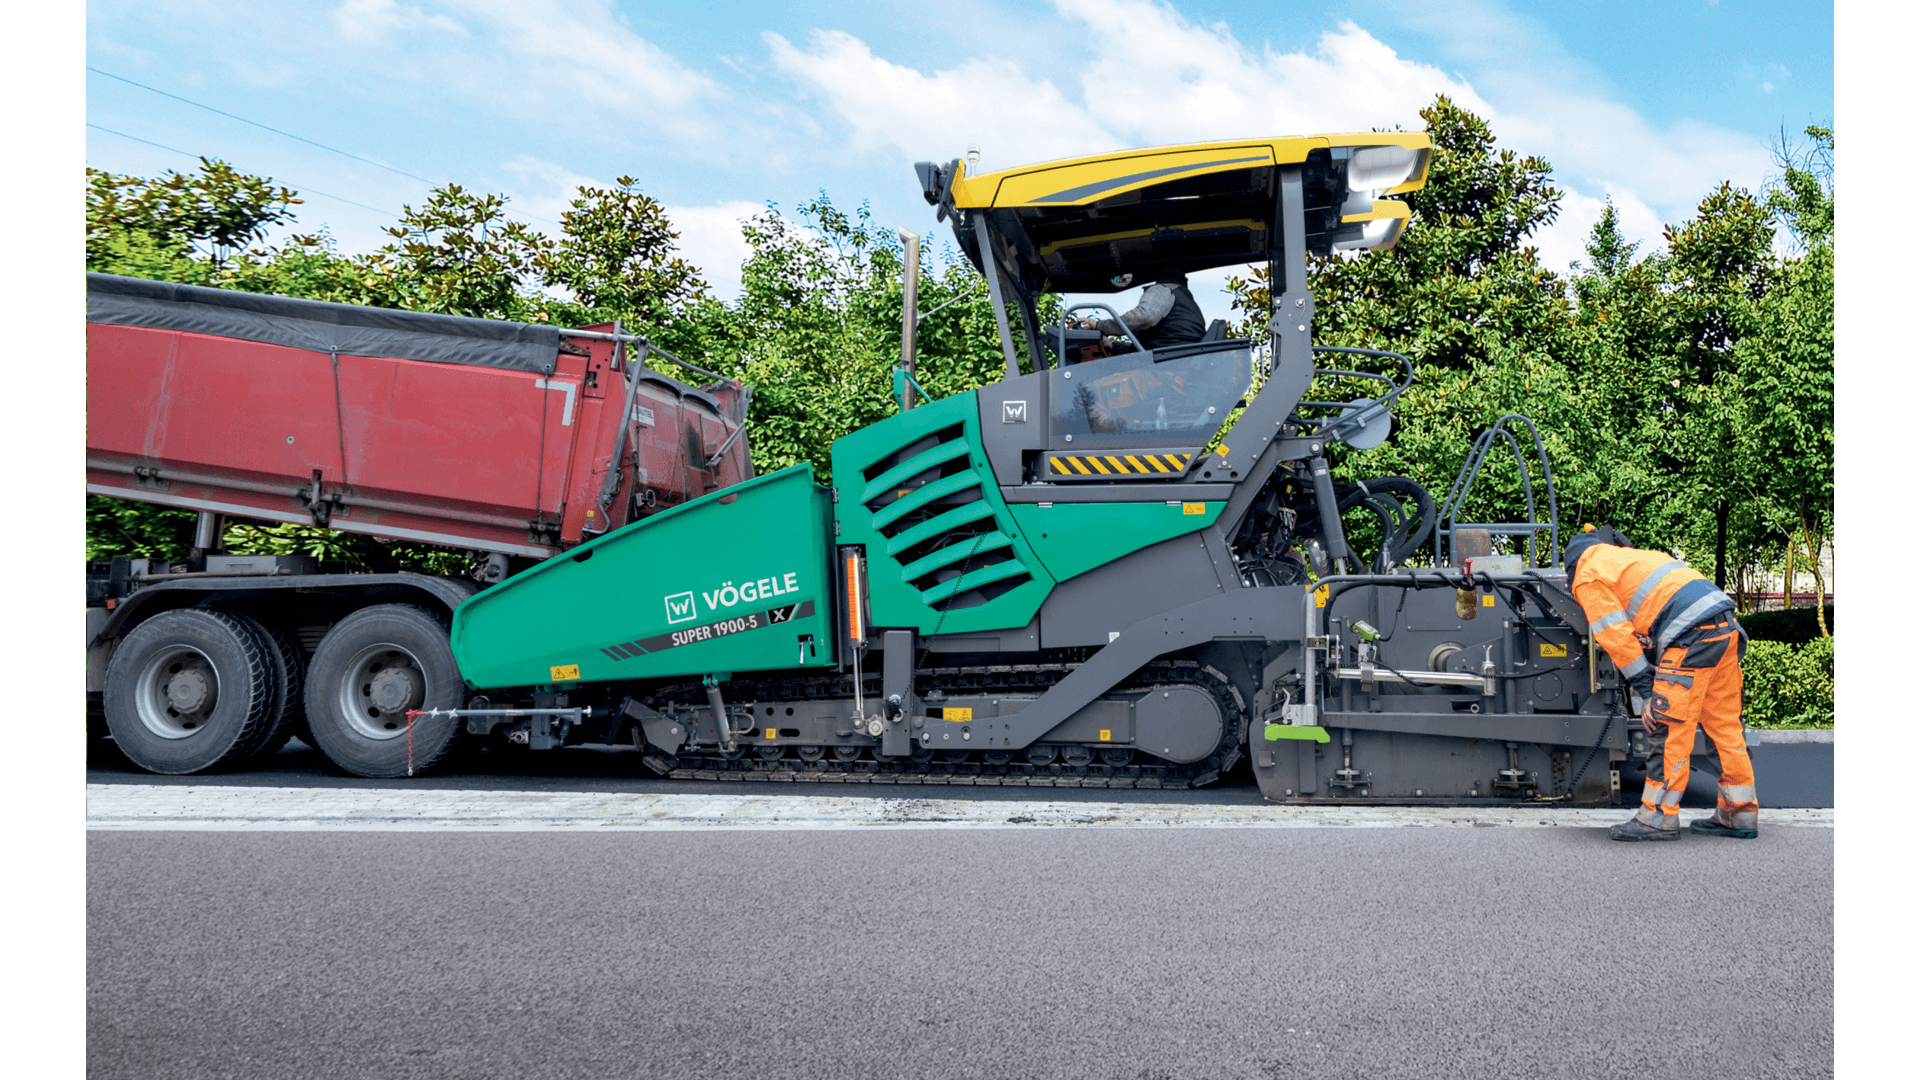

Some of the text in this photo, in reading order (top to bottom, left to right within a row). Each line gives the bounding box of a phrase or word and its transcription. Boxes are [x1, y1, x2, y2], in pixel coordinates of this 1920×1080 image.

[702, 572, 799, 610] VÖGELE
[672, 608, 785, 646] SUPER 1900-5 X
